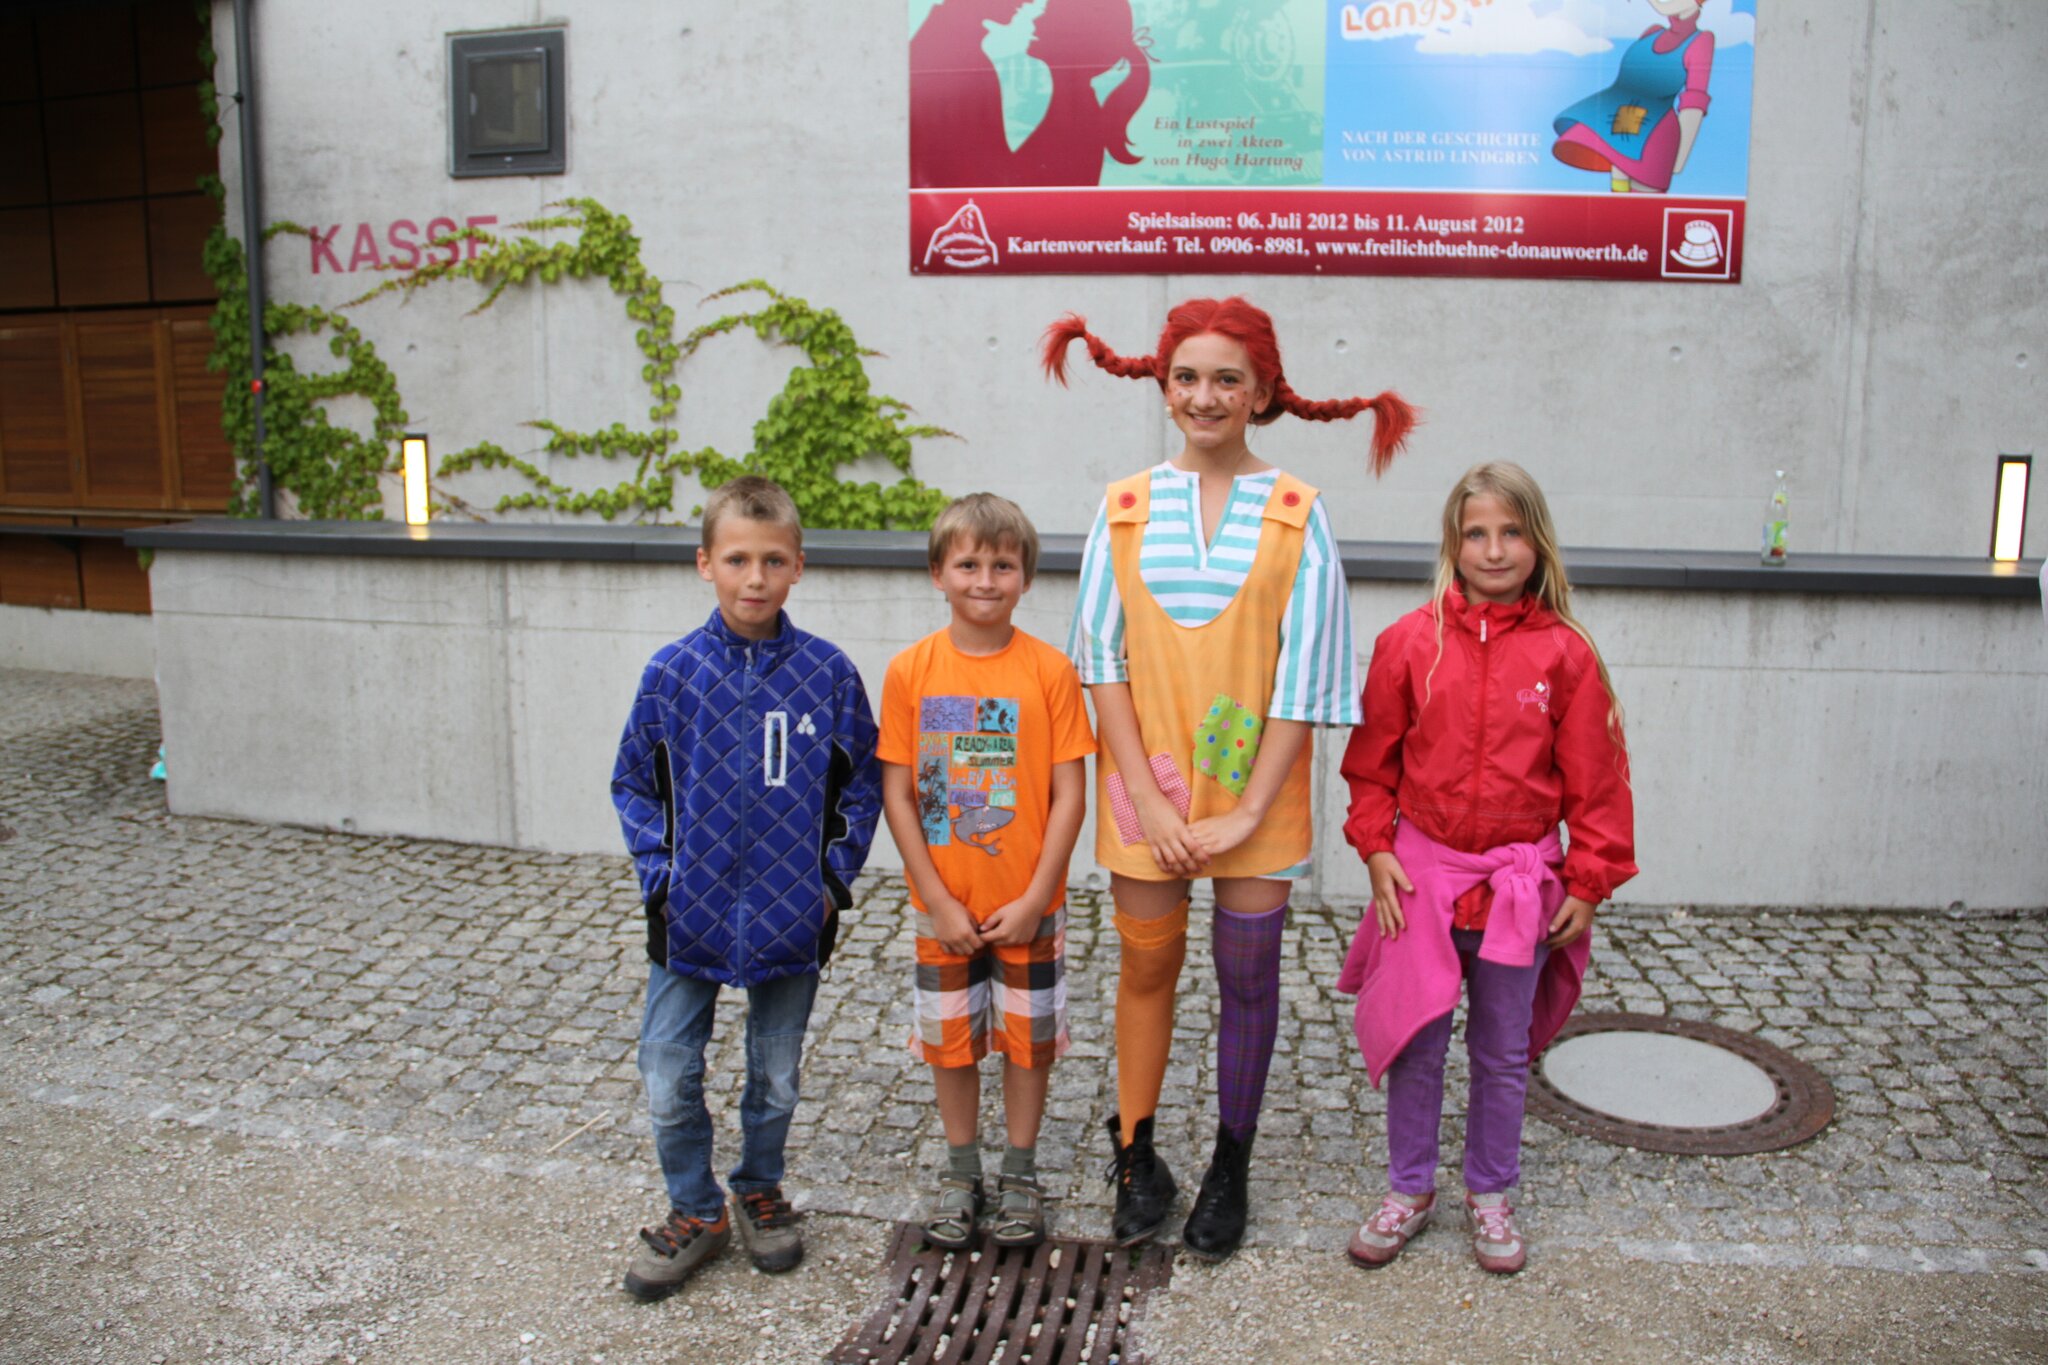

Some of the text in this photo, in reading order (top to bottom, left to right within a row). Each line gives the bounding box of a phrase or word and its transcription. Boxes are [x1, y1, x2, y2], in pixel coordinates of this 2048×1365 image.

[1154, 116, 1255, 133] Ein Lustspiel
[1178, 134, 1284, 148] in zwei Akten
[1341, 131, 1541, 147] NACH DER GESCHICHTE
[1153, 153, 1303, 171] von Hugo Hartung
[1341, 148, 1541, 165] VON ASTRID LINDGREN
[1127, 212, 1525, 236] Spielsaison: 06. Juli 2012 bis 11. August 2012
[1007, 236, 1168, 254] Kartenvorverkauf:
[1172, 236, 1205, 253] Tel.
[1315, 237, 1648, 262] www.freilichtbuehne-donauwoerth.de
